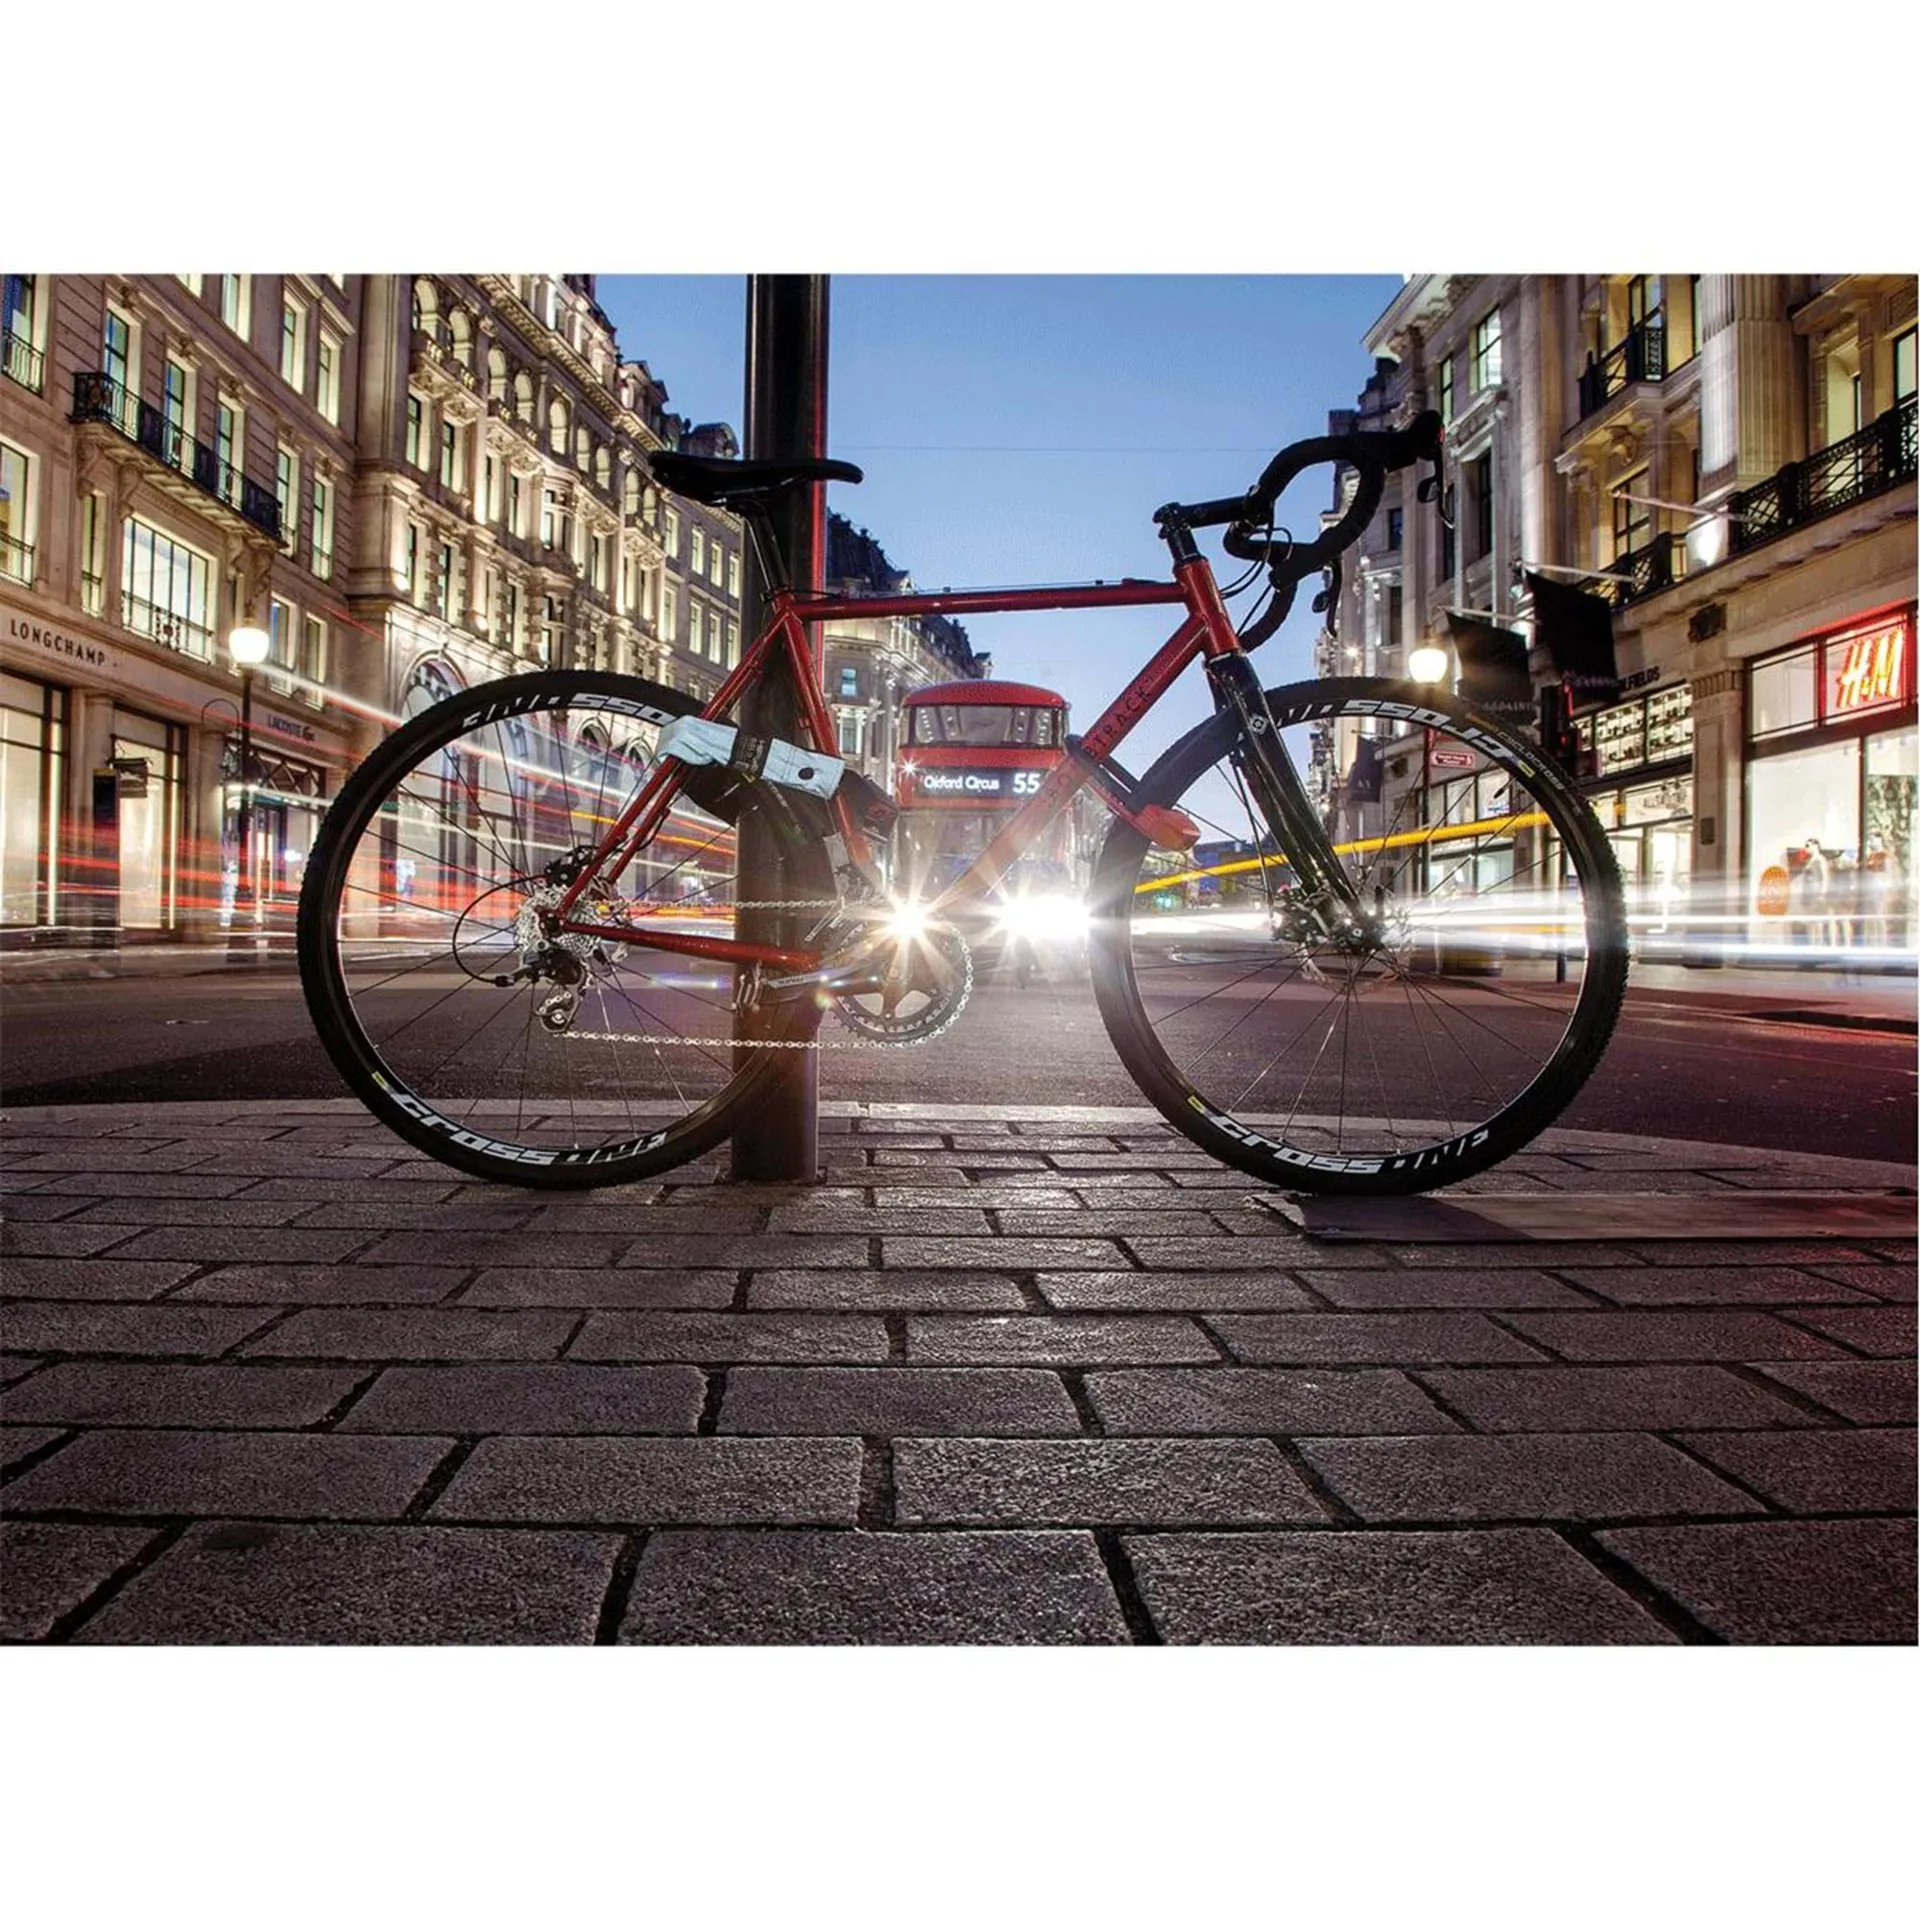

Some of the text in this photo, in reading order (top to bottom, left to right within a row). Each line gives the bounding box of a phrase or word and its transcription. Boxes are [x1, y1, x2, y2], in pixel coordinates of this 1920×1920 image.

[10, 618, 105, 667] LONGCHAMP
[1836, 628, 1904, 709] H&M
[924, 773, 1041, 794] Oxford Circus 55
